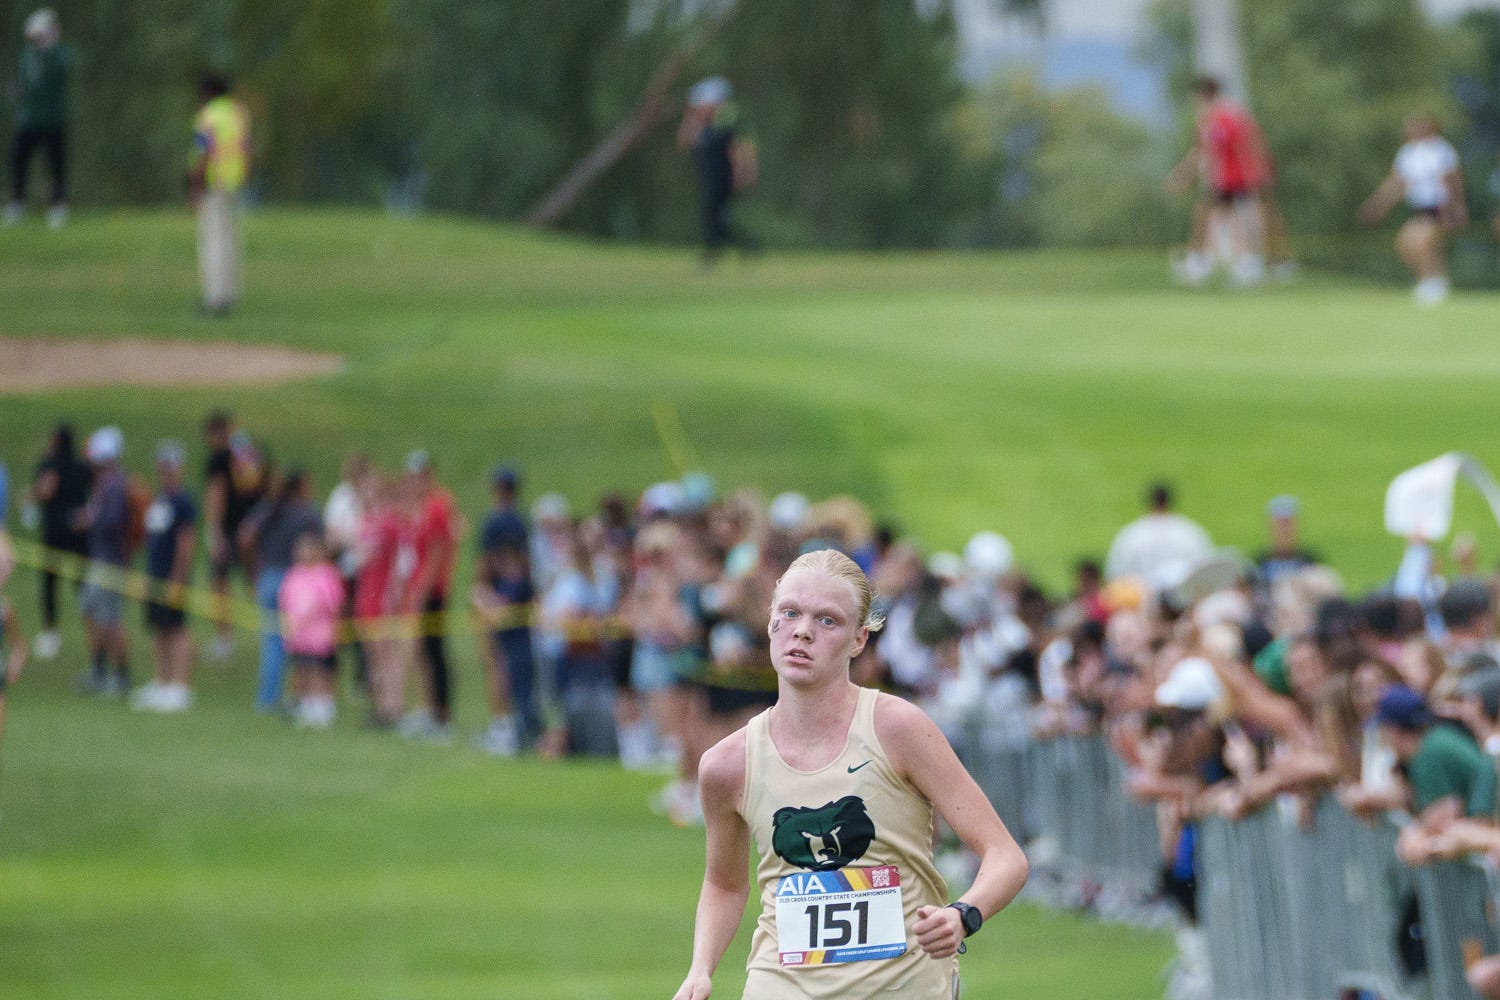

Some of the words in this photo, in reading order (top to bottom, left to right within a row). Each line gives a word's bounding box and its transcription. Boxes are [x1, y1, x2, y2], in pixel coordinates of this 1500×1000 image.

[778, 875, 826, 895] AIA
[851, 889, 897, 899] CHAMPIONSHIPS
[804, 901, 869, 948] 151
